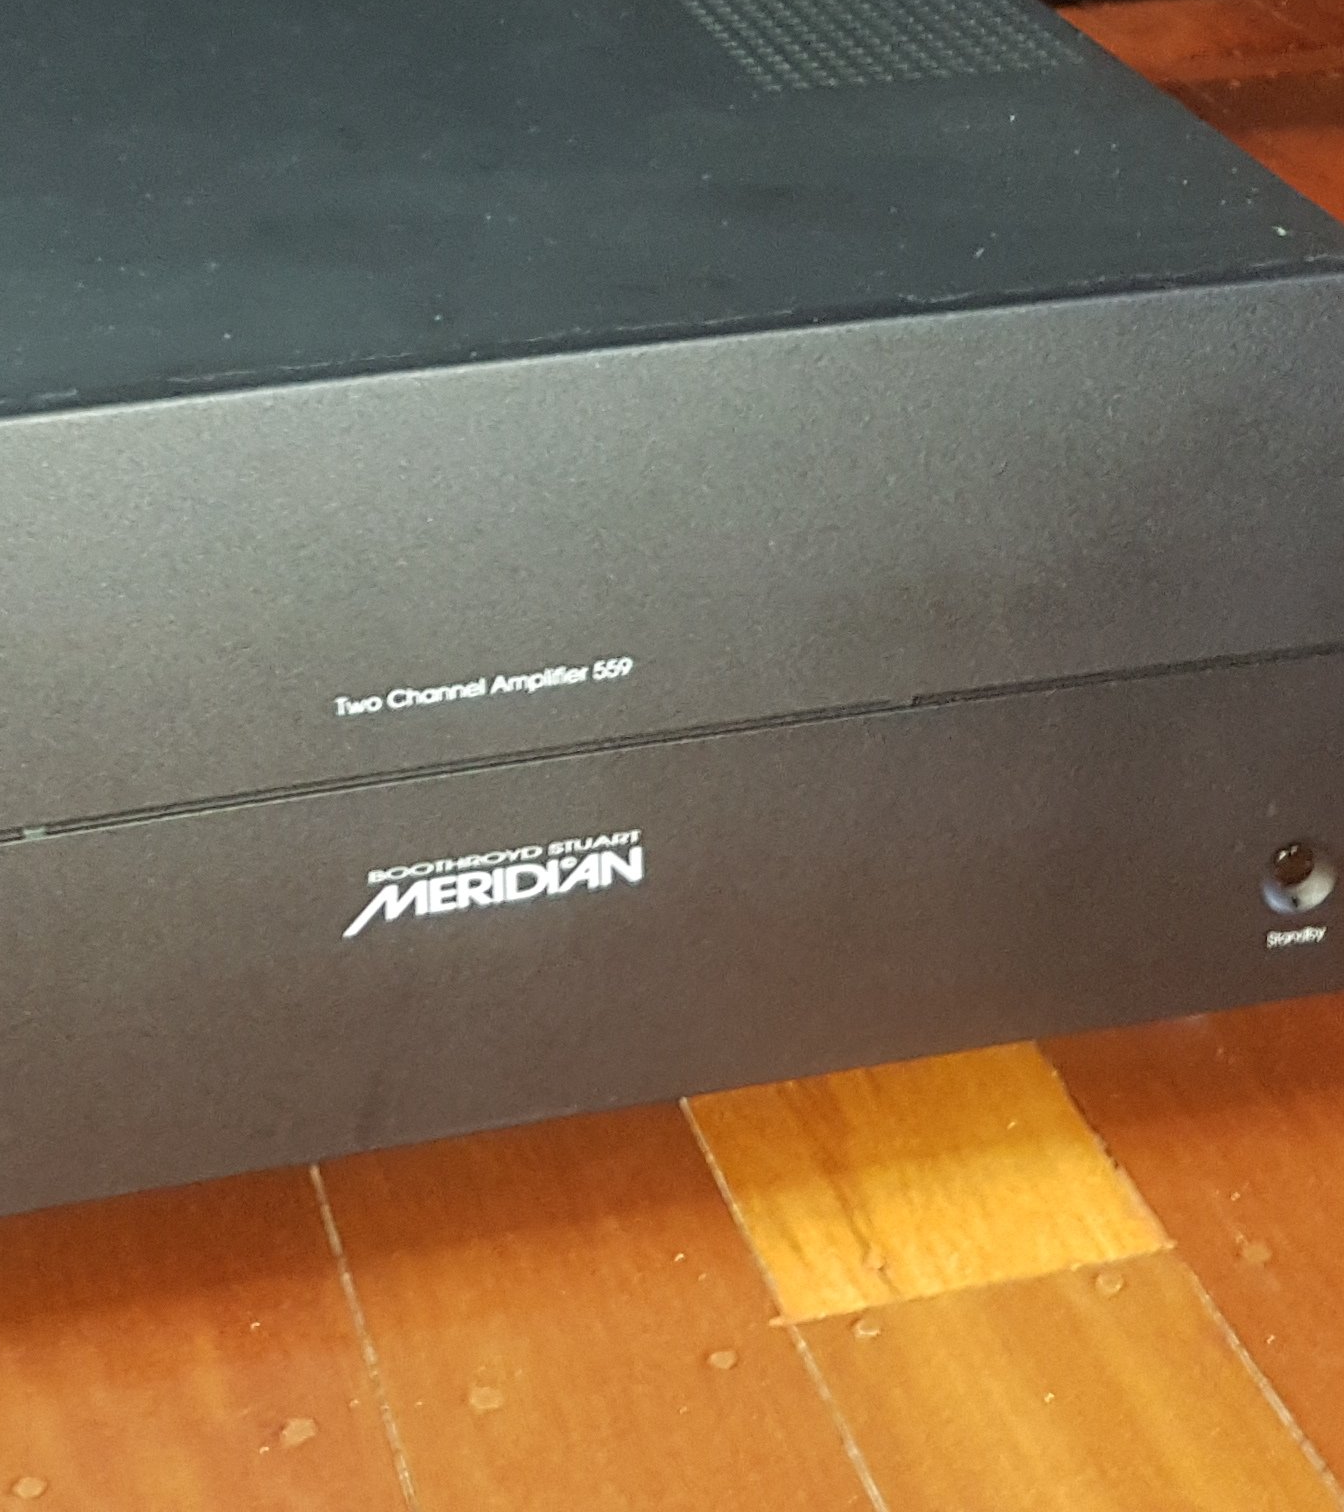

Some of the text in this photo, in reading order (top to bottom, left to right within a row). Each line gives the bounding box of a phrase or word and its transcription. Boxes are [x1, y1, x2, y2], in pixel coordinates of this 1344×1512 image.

[334, 656, 635, 716] Two Channel Amplifier 559
[367, 828, 643, 886] BOOTHROYD STUART
[341, 845, 645, 939] MERIDIAN
